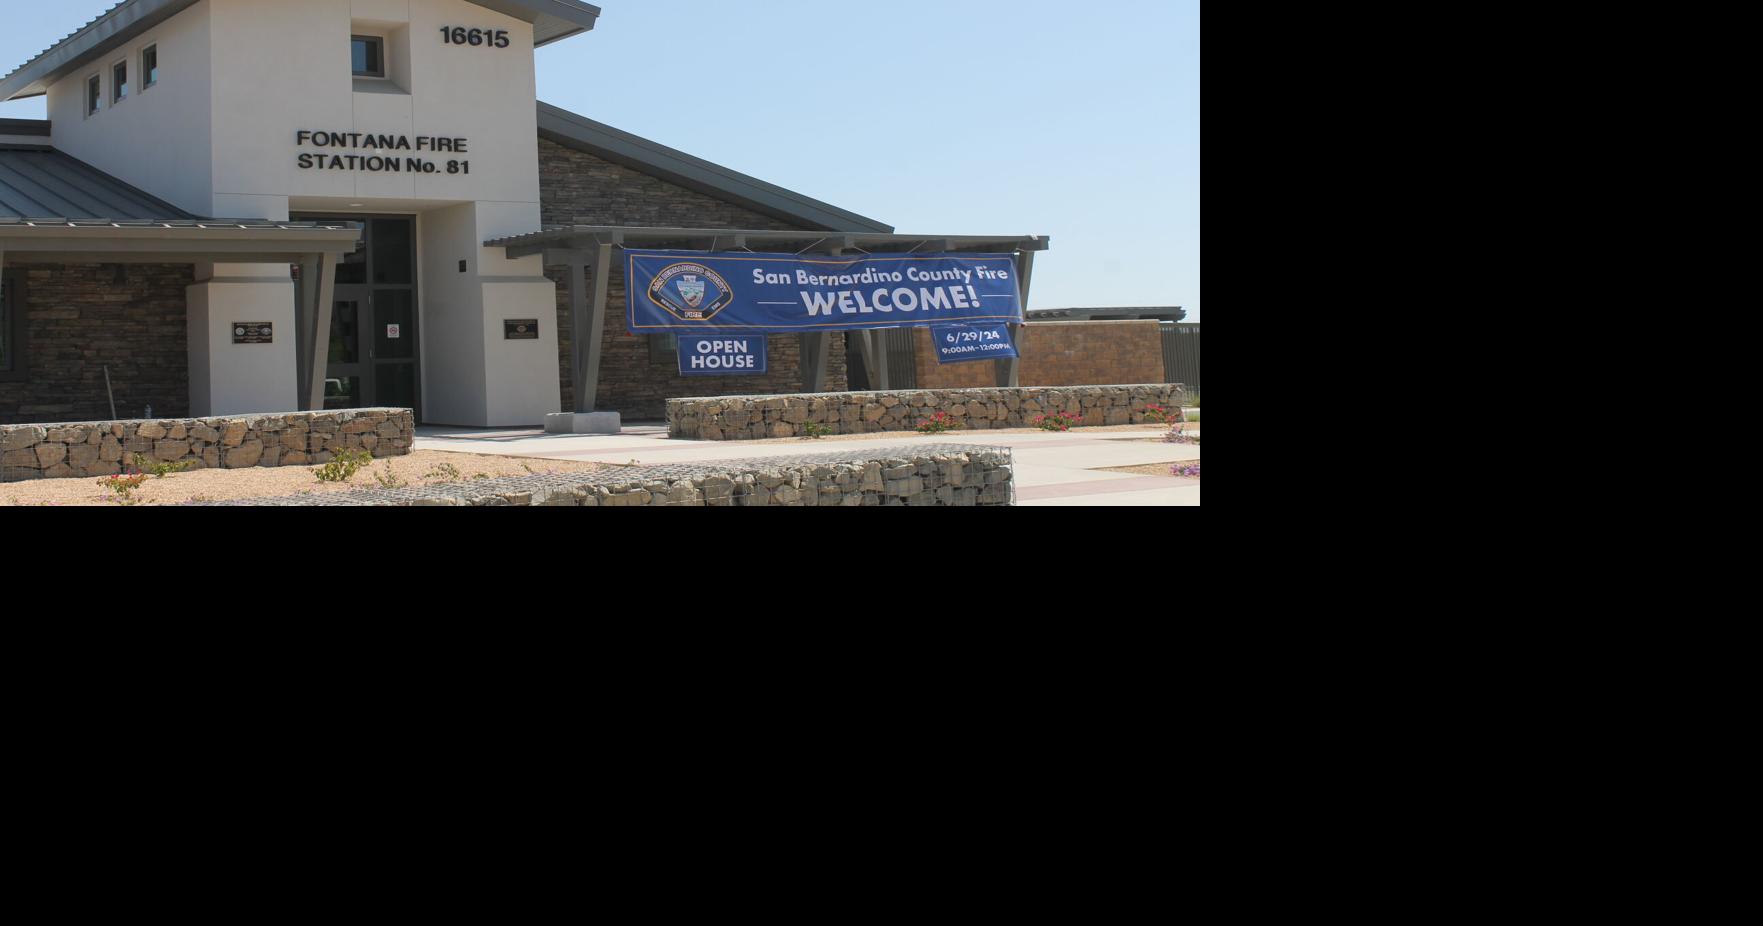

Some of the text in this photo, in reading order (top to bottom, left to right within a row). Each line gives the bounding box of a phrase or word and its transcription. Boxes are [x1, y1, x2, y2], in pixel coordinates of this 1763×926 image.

[440, 26, 509, 48] 16615
[297, 131, 468, 153] FONTANA FIRE
[298, 153, 470, 174] STATION No. 81
[753, 265, 1009, 286] San Bernardino County Fire
[800, 285, 981, 316] WELCOME!
[696, 340, 748, 354] OPEN
[946, 331, 1000, 344] 6/29/24
[691, 355, 754, 369] HOUSE
